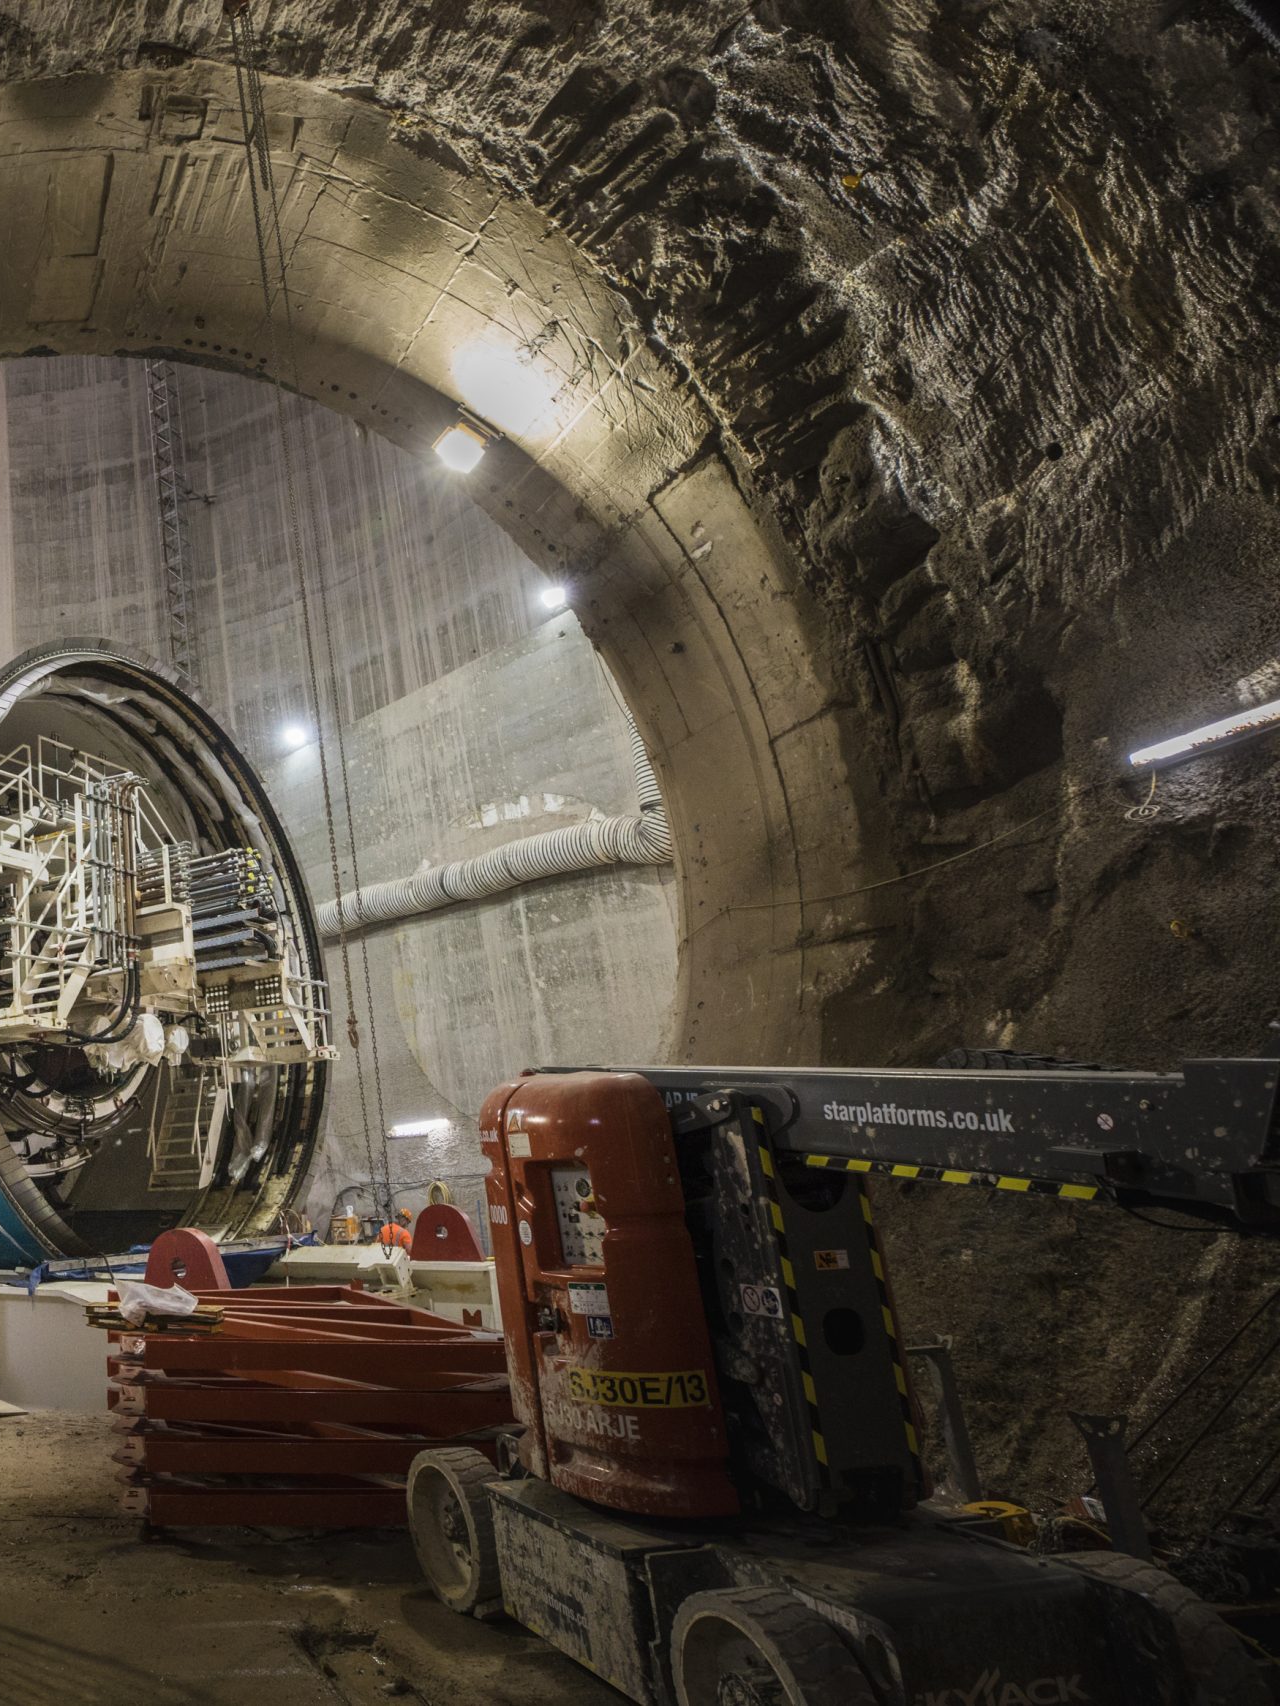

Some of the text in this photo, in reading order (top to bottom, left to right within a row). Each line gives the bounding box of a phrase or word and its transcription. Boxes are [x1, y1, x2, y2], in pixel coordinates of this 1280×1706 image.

[823, 1100, 1015, 1133] starplatforms.co.uk
[569, 1371, 706, 1405] SJ30E/13
[586, 1408, 642, 1440] ARJE
